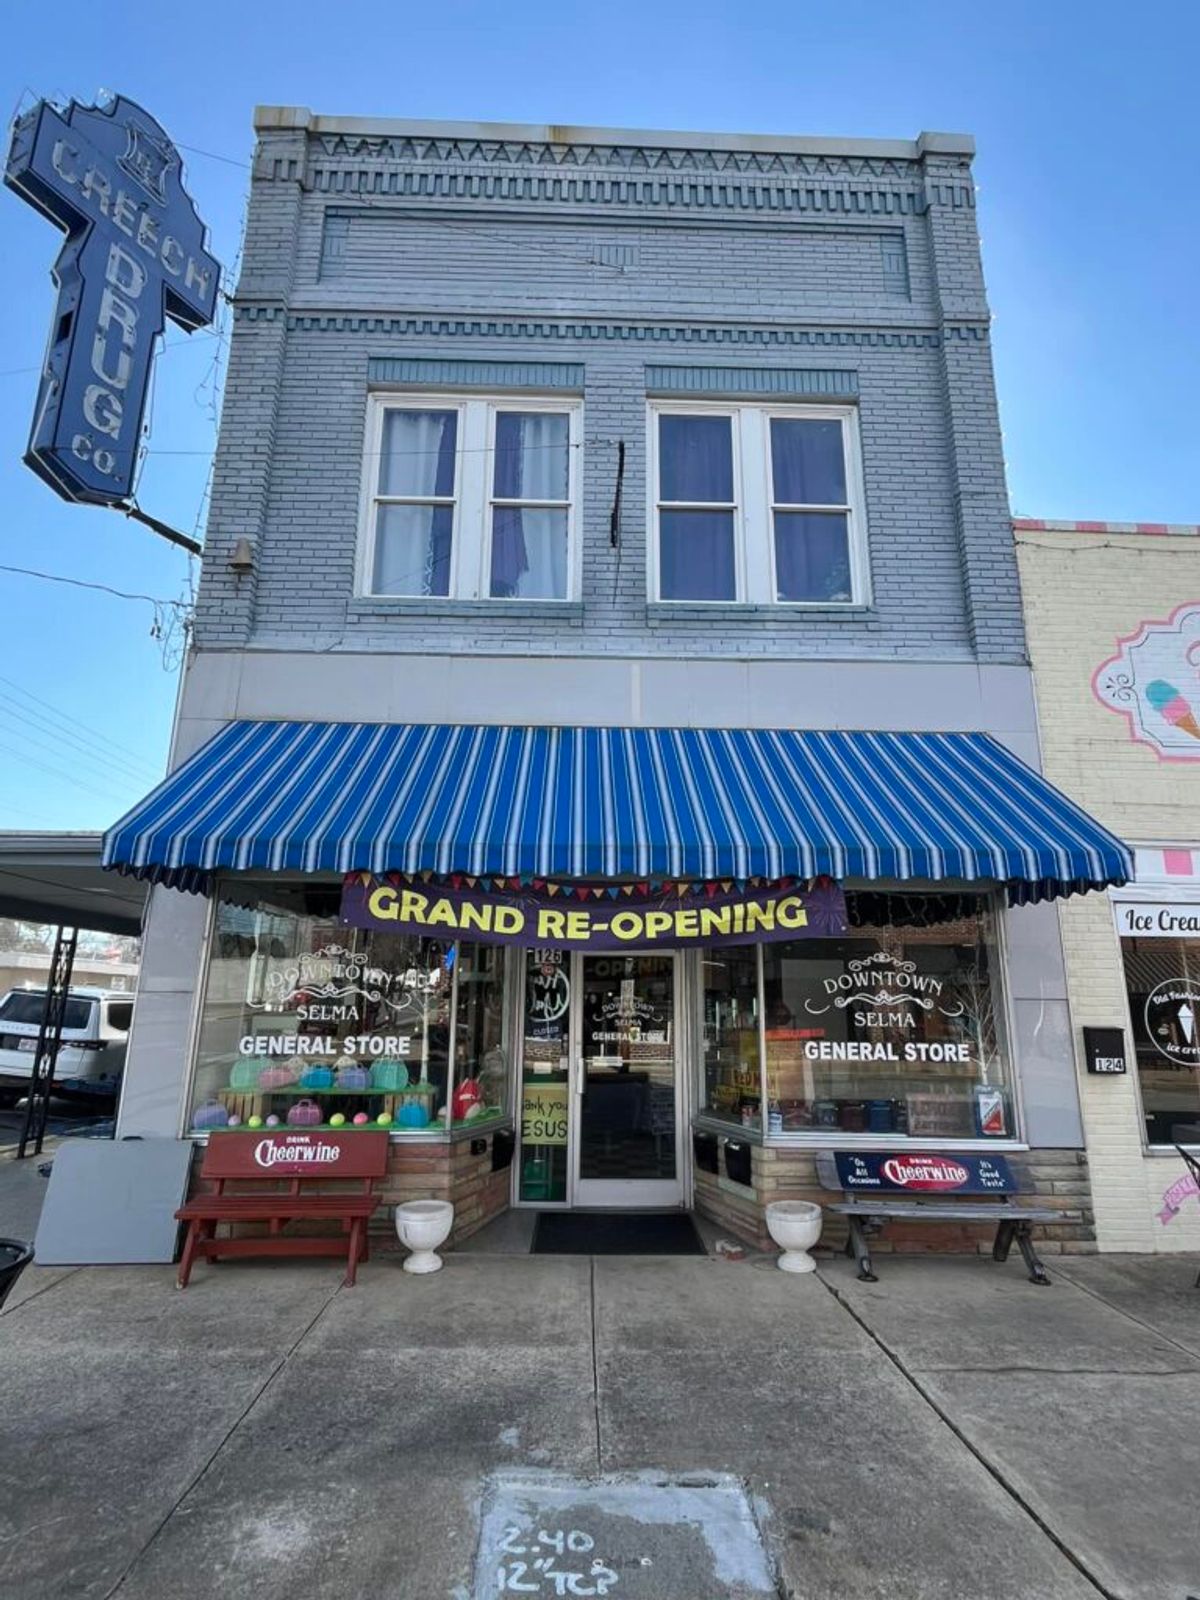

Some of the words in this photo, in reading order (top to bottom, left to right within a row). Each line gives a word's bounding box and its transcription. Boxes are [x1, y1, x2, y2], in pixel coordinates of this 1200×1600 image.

[51, 138, 210, 300] CREECH
[83, 241, 148, 441] DRUG
[368, 886, 525, 935] GRAND
[537, 896, 808, 940] RE-OPENING
[1125, 909, 1153, 930] Ice
[1158, 909, 1200, 931] Crea
[823, 970, 943, 996] DOWNTOWN
[297, 1004, 359, 1020] SELMA
[854, 1012, 916, 1028] SELMA
[239, 1035, 337, 1055] GENERAL
[343, 1035, 411, 1055] STORE
[804, 1041, 899, 1061] GENERAL
[904, 1043, 970, 1062] STORE
[1098, 1059, 1122, 1070] 124
[521, 1095, 546, 1117] ank
[286, 1136, 311, 1144] DRINK
[520, 1119, 568, 1139] ESUS
[254, 1139, 340, 1167] Cheerwine
[884, 1159, 969, 1184] Cheerwine
[498, 1527, 595, 1554] 2.40
